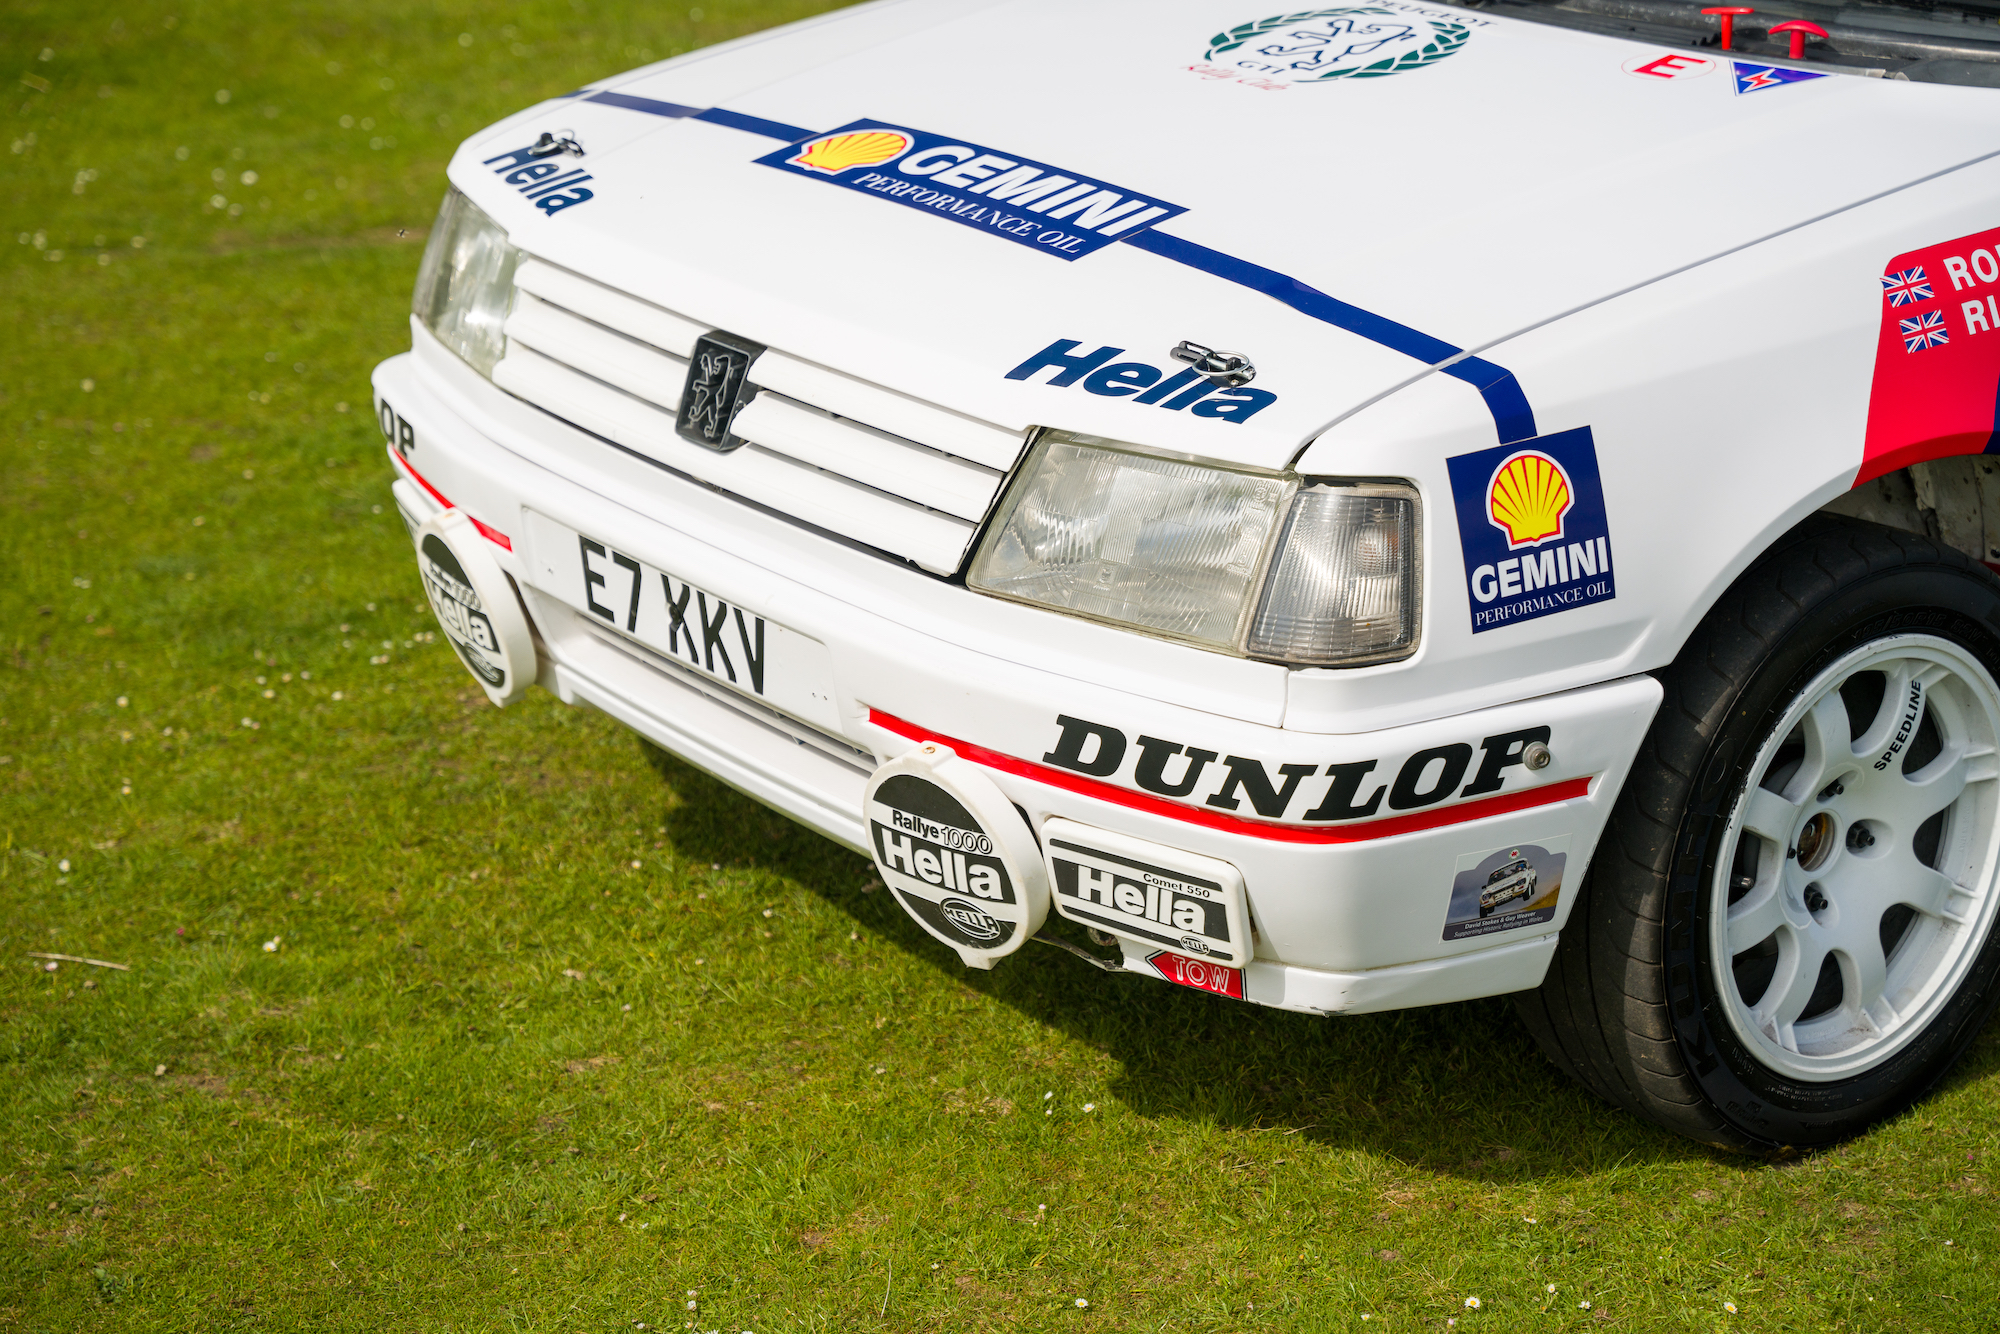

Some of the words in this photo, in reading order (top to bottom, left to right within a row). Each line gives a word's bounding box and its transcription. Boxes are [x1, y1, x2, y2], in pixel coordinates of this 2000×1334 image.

[1236, 60, 1286, 75] GTI
[1632, 54, 1707, 79] E
[852, 172, 1042, 237] PERFORMANCE
[1036, 229, 1086, 254] OIL
[898, 145, 1169, 238] GEMINI
[1942, 244, 2000, 291] RO
[1003, 338, 1278, 424] Hella
[1471, 536, 1610, 603] GEMINI
[427, 576, 494, 650] Hella
[578, 533, 642, 633] E7
[660, 572, 765, 696] XKV
[1475, 587, 1583, 627] PERFORMANCE
[1586, 581, 1611, 598] OIL
[1873, 680, 1921, 771] SPEEDLINE
[1042, 713, 1552, 821] DUNLOP
[892, 809, 940, 839] Rallye
[940, 826, 993, 855] 1000
[881, 827, 1004, 900] Hella
[1143, 873, 1183, 892] Comet
[1187, 885, 1210, 898] 550
[944, 906, 1000, 936] HELLA
[1077, 864, 1206, 935] Hella
[1464, 921, 1481, 930] David
[1481, 918, 1500, 927] Stokes
[1505, 915, 1516, 923] Guy
[1516, 911, 1536, 920] Weaver
[1172, 954, 1230, 993] TOW
[1182, 938, 1209, 953] HELLA
